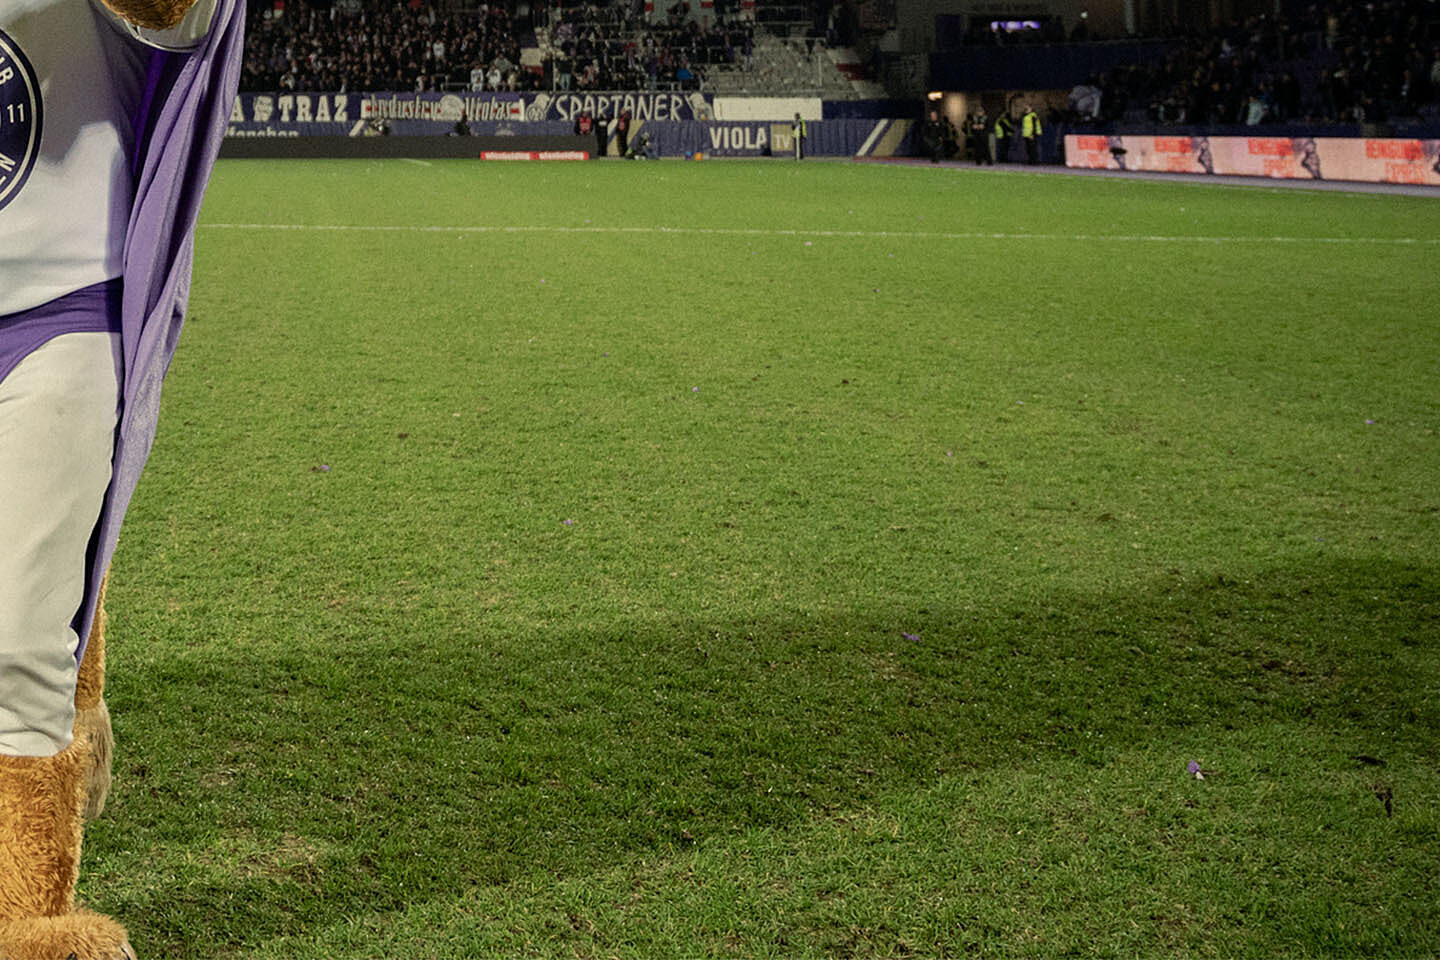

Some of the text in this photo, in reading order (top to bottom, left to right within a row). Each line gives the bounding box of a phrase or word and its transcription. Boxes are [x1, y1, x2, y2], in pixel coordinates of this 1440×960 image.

[6, 103, 26, 124] 11
[556, 93, 683, 121] SPARTANER
[709, 126, 791, 150] VIOLA TV
